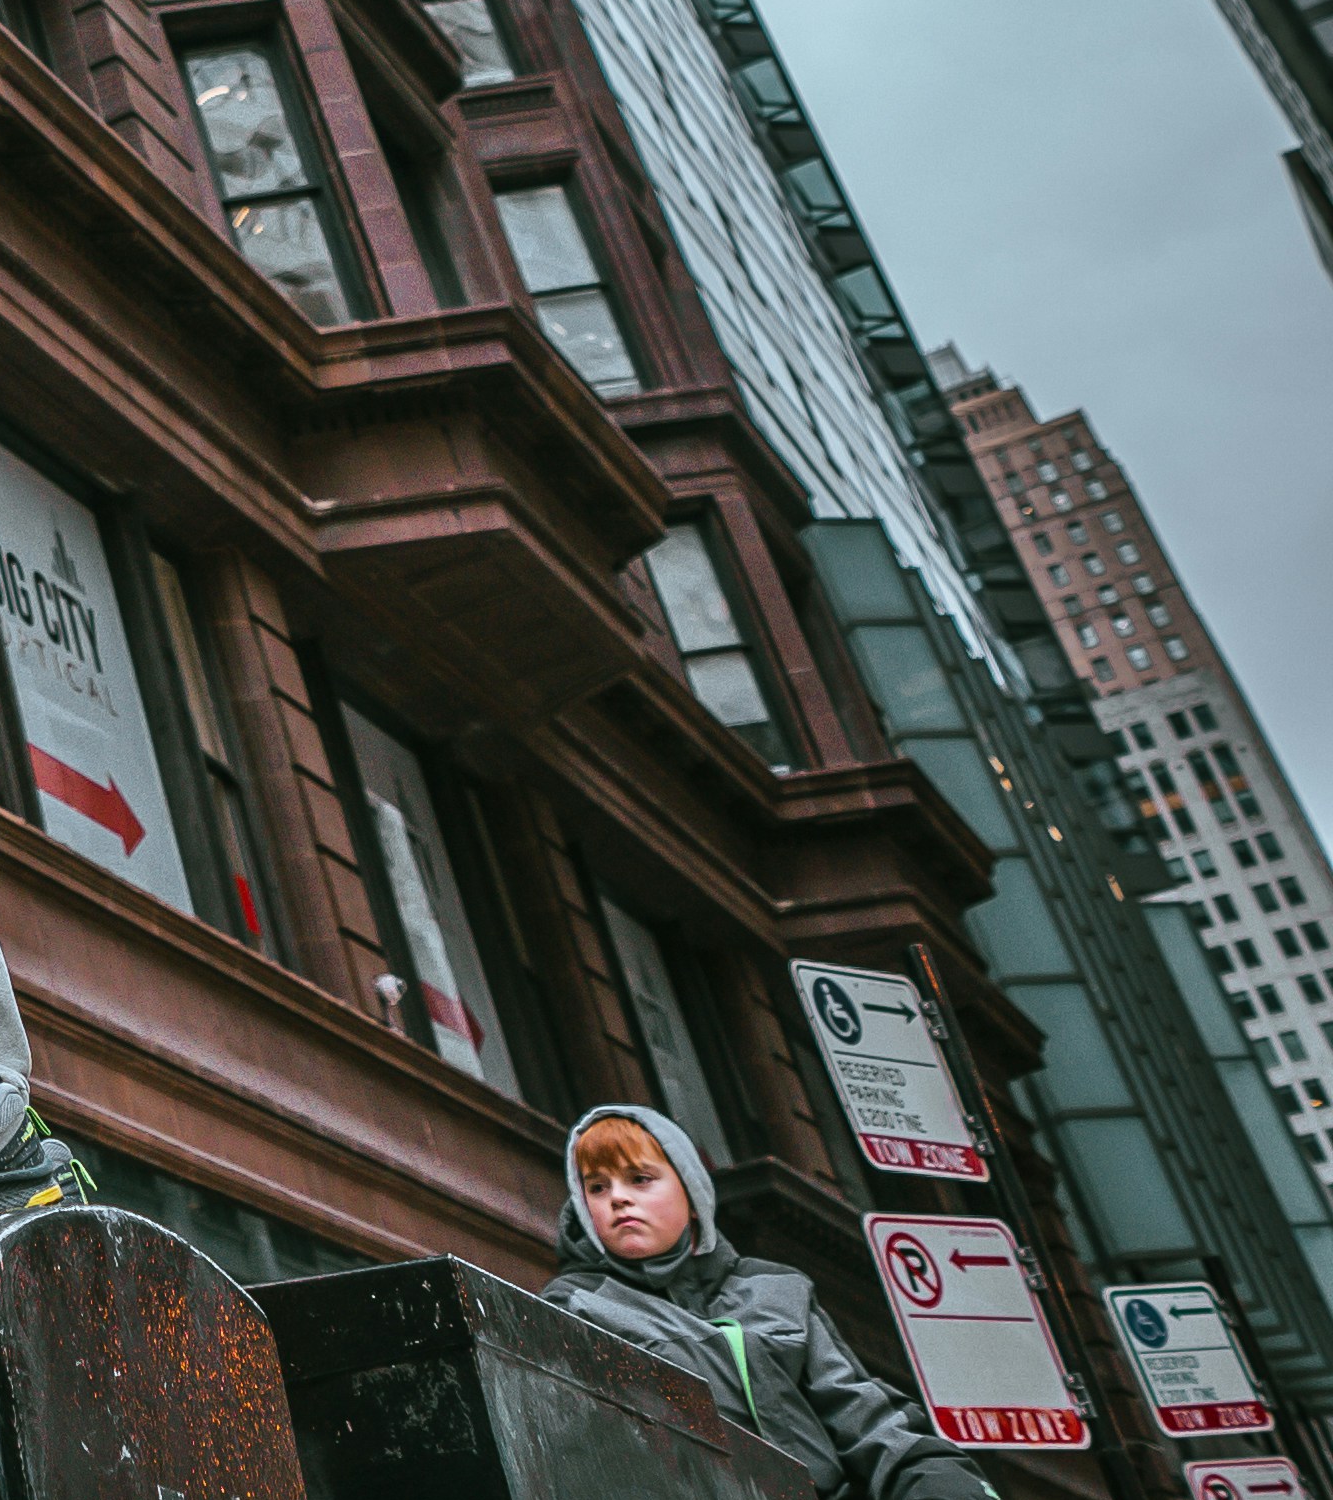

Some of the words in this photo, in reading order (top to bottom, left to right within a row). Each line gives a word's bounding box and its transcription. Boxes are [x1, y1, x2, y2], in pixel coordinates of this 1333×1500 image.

[33, 570, 103, 674] CITY
[868, 1137, 915, 1166] TOW
[916, 1143, 975, 1172] ZONE
[951, 1410, 1003, 1441] TOW
[1005, 1408, 1073, 1442] ZONE
[1171, 1409, 1208, 1429] TOW
[1216, 1406, 1263, 1426] ZONE
